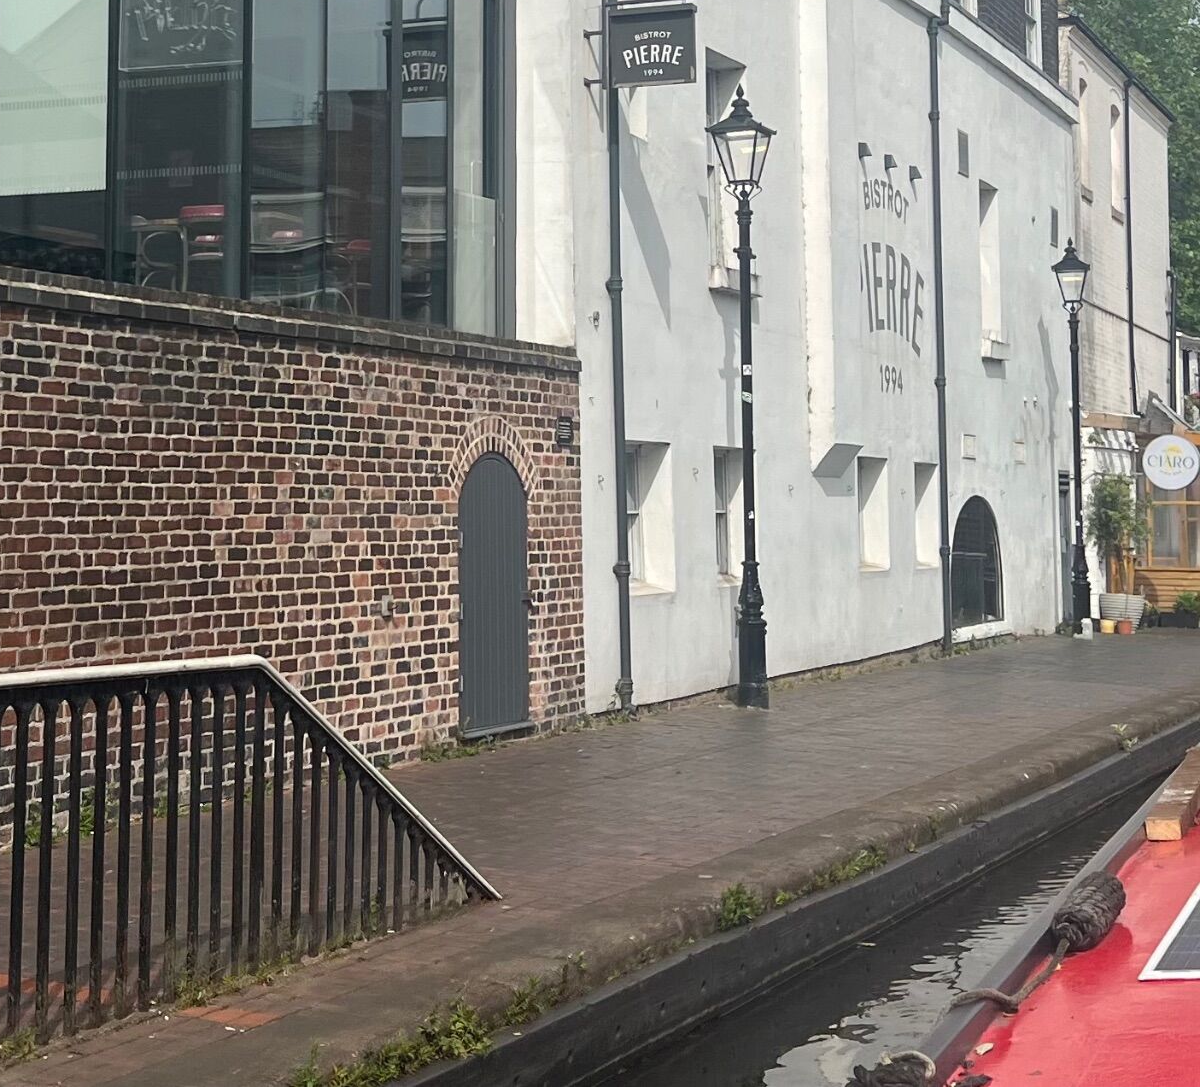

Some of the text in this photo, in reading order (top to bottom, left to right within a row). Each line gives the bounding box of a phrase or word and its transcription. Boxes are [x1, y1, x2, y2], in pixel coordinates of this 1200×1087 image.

[634, 31, 672, 42] BISTROT
[622, 44, 684, 68] PIERRE
[643, 68, 663, 76] 1994
[862, 179, 910, 224] BISTROT
[860, 242, 924, 357] IERRE
[879, 364, 904, 395] 1994
[1147, 454, 1195, 469] CIARO
